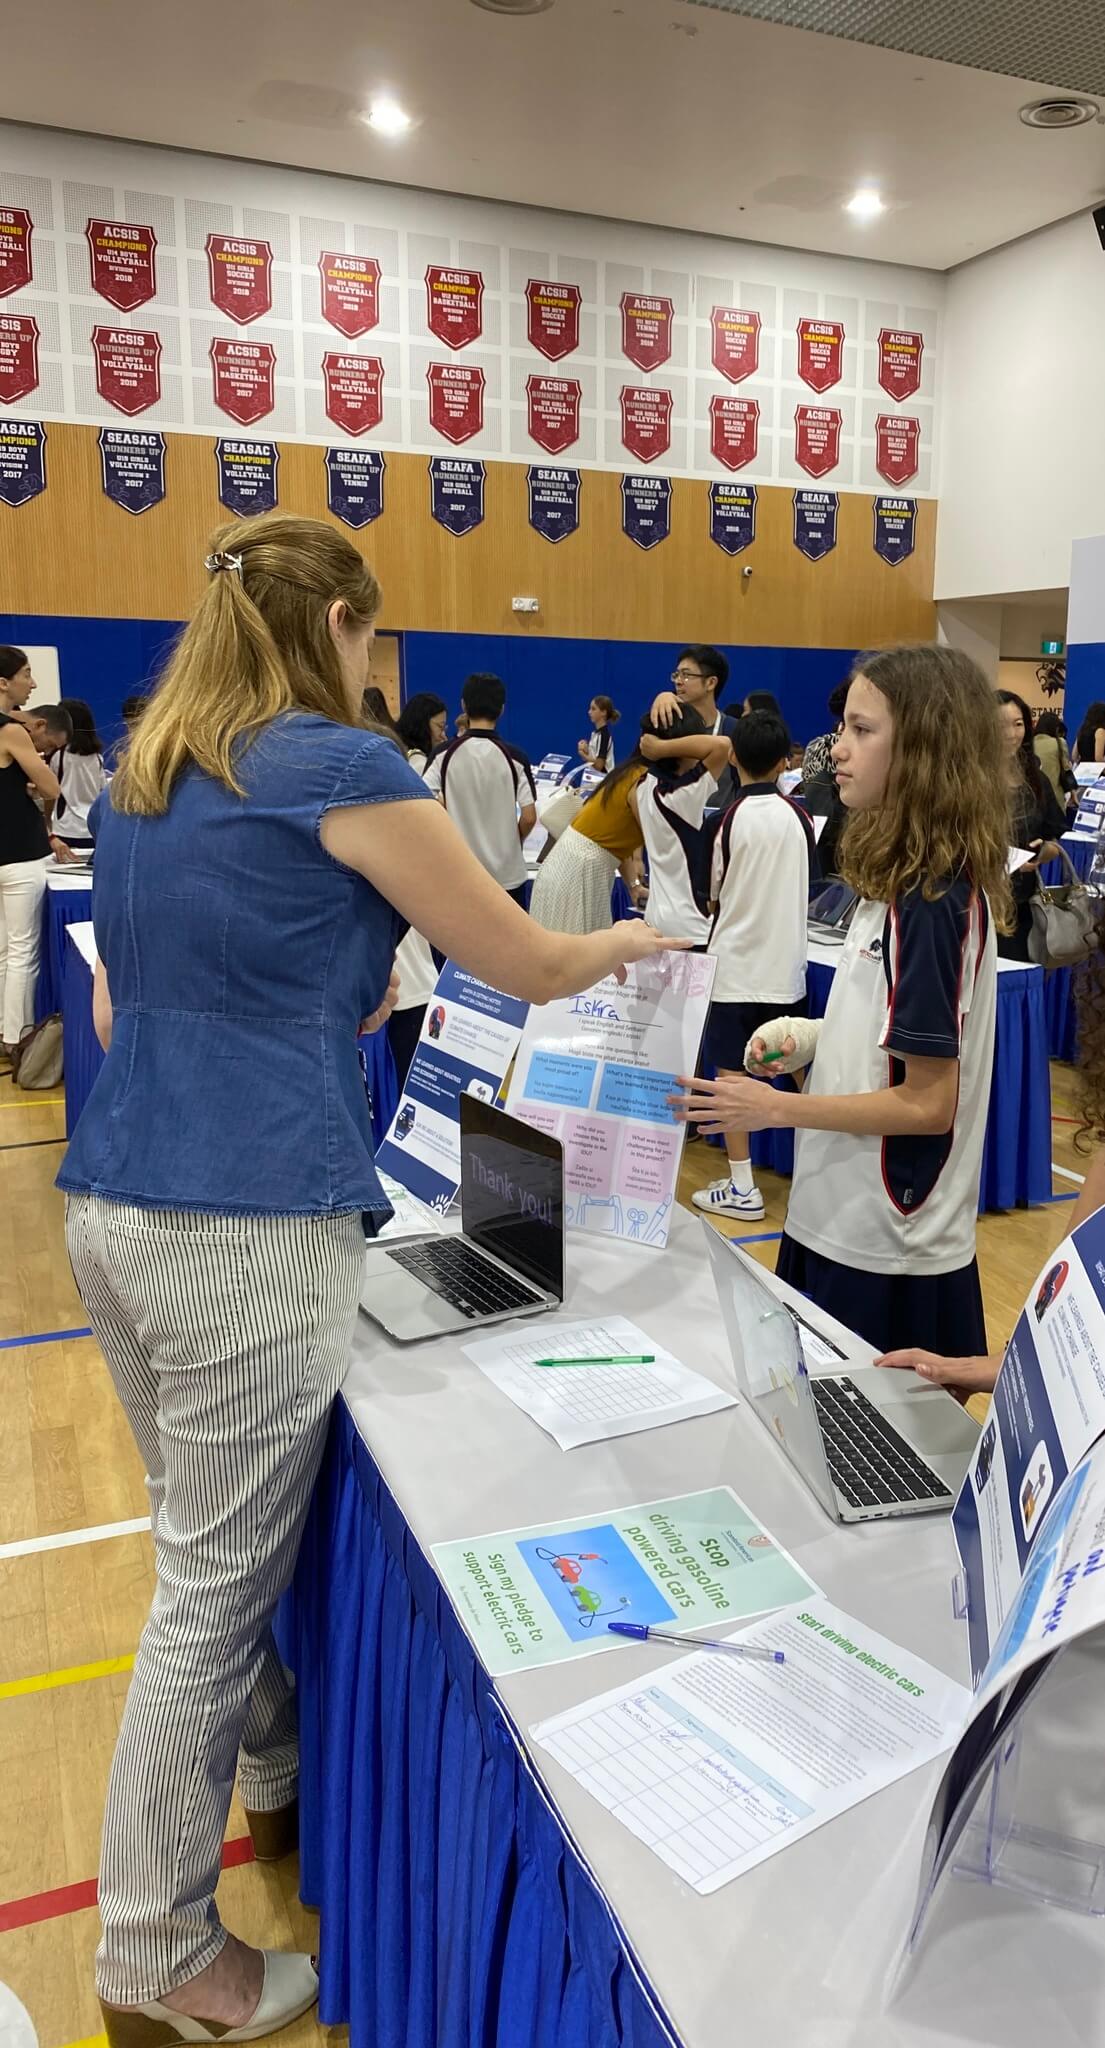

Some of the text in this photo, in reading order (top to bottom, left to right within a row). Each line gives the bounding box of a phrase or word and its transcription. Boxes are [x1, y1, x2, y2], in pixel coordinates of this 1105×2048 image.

[104, 227, 139, 240] ACSIS
[97, 239, 147, 251] CHAMPIONS
[223, 242, 257, 254] ACSIS
[97, 255, 148, 266] VOLLEYBALL
[216, 253, 264, 266] CHAMPIONS
[334, 259, 366, 271] ACSIS
[227, 271, 254, 279] SOCCER
[328, 270, 372, 282] CHAMPIONS
[440, 272, 469, 285] ACSIS
[328, 285, 373, 297] VOLLEYBALL
[434, 284, 475, 294] CHAMPIONS
[540, 286, 568, 298] ACSIS
[433, 298, 476, 309] BASKETBALL
[534, 297, 573, 308] CHAMPIONS
[634, 299, 661, 310] ACSIS
[542, 312, 565, 321] SOCCER
[628, 309, 666, 320] CHAMPIONS
[724, 312, 749, 324] ACSIS
[718, 322, 754, 333] CHAMPIONS
[809, 324, 833, 334] ACSIS
[20, 334, 32, 342] UP
[109, 333, 144, 345] ACSIS
[803, 333, 838, 344] CHAMPIONS
[889, 334, 912, 345] ACSIS
[100, 344, 155, 356] RUNNERS UP
[227, 345, 260, 357] ACSIS
[884, 344, 917, 353] CHAMPIONS
[102, 360, 153, 371] VOLLEYBALL
[218, 356, 255, 366] RUNNERS
[337, 358, 369, 370] ACSIS
[220, 371, 268, 382] BASKETBALL
[329, 369, 365, 379] RUNNERS
[442, 369, 471, 380] ACSIS
[331, 384, 376, 394] VOLLEYBALL
[433, 379, 467, 389] RUNNERS
[540, 381, 568, 392] ACSIS
[532, 391, 564, 400] RUNNERS
[633, 391, 660, 402] ACSIS
[534, 405, 573, 415] VOLLEYBALL
[626, 401, 656, 410] RUNNERS
[723, 401, 748, 412] ACSIS
[627, 415, 665, 424] VOLLEYBALL
[716, 411, 744, 419] RUNNERS
[806, 410, 831, 421] ACSIS
[886, 419, 909, 429] ACSIS
[107, 433, 156, 445] SEASAC
[105, 445, 146, 454] RUNNERS
[224, 443, 270, 455] SEASAC
[224, 455, 271, 465] CHAMPIONS
[337, 453, 372, 464] SEAFA
[109, 462, 157, 470] VOLLEYBALL
[331, 463, 367, 472] RUNNERS
[440, 461, 474, 473] SEAFA
[3, 470, 22, 478] 2017
[225, 470, 270, 480] VOLLEYBALL
[434, 472, 468, 481] RUNNERS
[538, 470, 570, 481] SEAFA
[532, 480, 565, 489] RUNNERS
[631, 479, 661, 489] SEAFA
[442, 487, 473, 495] SOFTBALL
[626, 489, 656, 497] RUNNERS
[719, 486, 747, 496] SEAFA
[535, 495, 573, 504] BASKETBALL
[715, 496, 751, 505] CHAMPIONS
[802, 493, 830, 503] SEAFA
[882, 500, 908, 510] SEAFA
[716, 510, 750, 518] VOLLEYBALL
[879, 509, 912, 518] CHAMPIONS
[454, 971, 472, 983] CLIMATE
[568, 995, 620, 1021] Iskra
[626, 1142, 653, 1152] challenging
[469, 1152, 552, 1224] Thank you!
[700, 1539, 729, 1567] Stop
[650, 1514, 730, 1609] driving gasoline
[623, 1527, 696, 1608] powered cars
[463, 1552, 492, 1590] support
[484, 1591, 513, 1629] electric
[504, 1631, 524, 1654] cars
[488, 1554, 543, 1641] Sign my pledge to
[797, 1613, 924, 1697] Start driving electric cars
